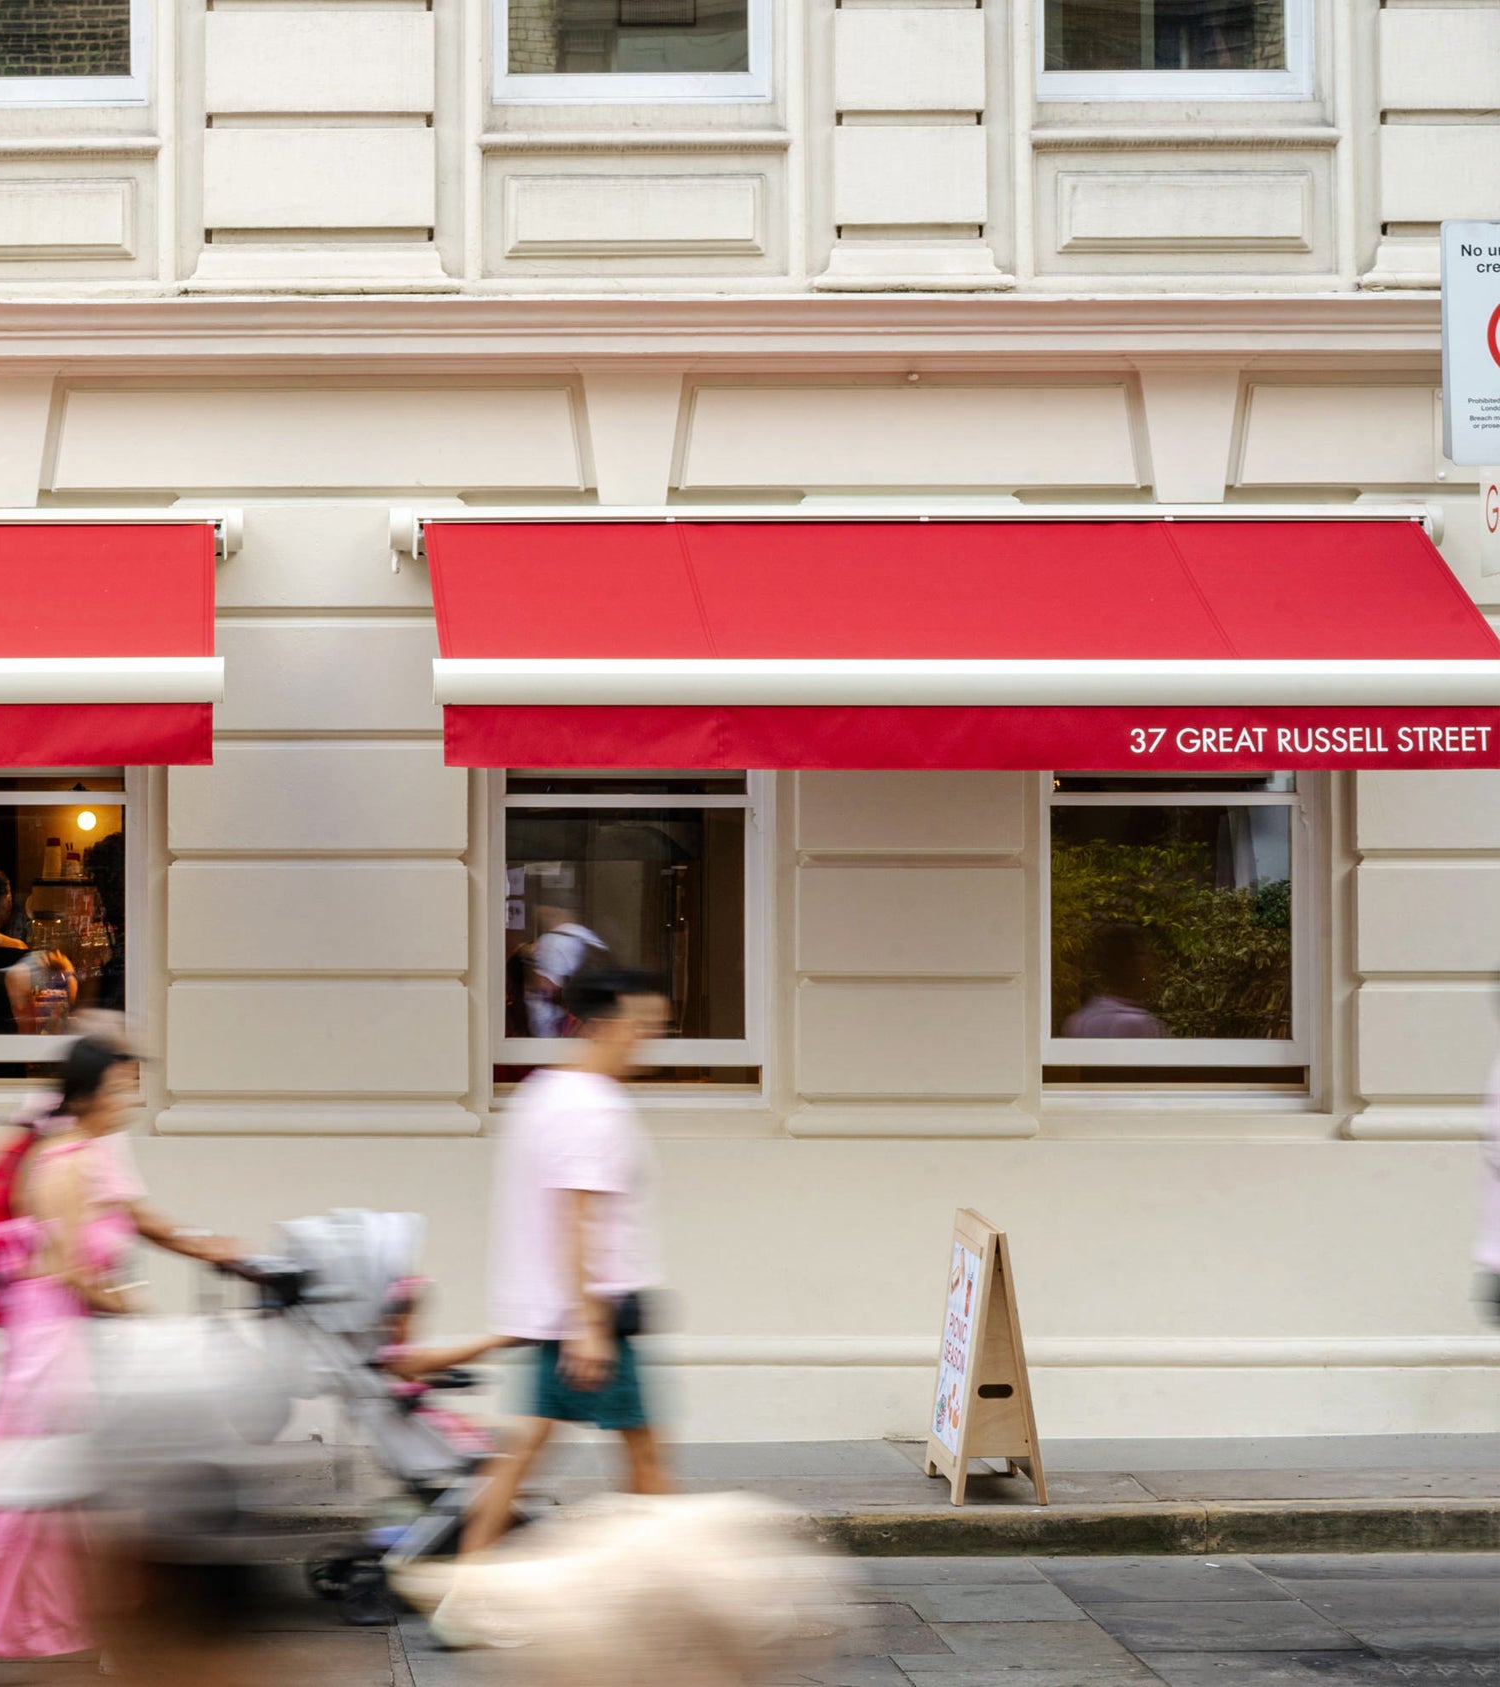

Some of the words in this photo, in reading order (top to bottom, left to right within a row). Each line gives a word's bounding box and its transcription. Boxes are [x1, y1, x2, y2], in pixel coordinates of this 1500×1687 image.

[1461, 244, 1483, 257] No
[1488, 246, 1500, 257] u
[1476, 263, 1500, 273] cre
[1129, 727, 1167, 753] 37
[1175, 727, 1268, 753] GREAT
[1277, 727, 1389, 753] RUSSELL
[1397, 726, 1492, 752] STREET
[948, 1312, 968, 1345] PICNIC
[943, 1339, 966, 1375] SEASON
